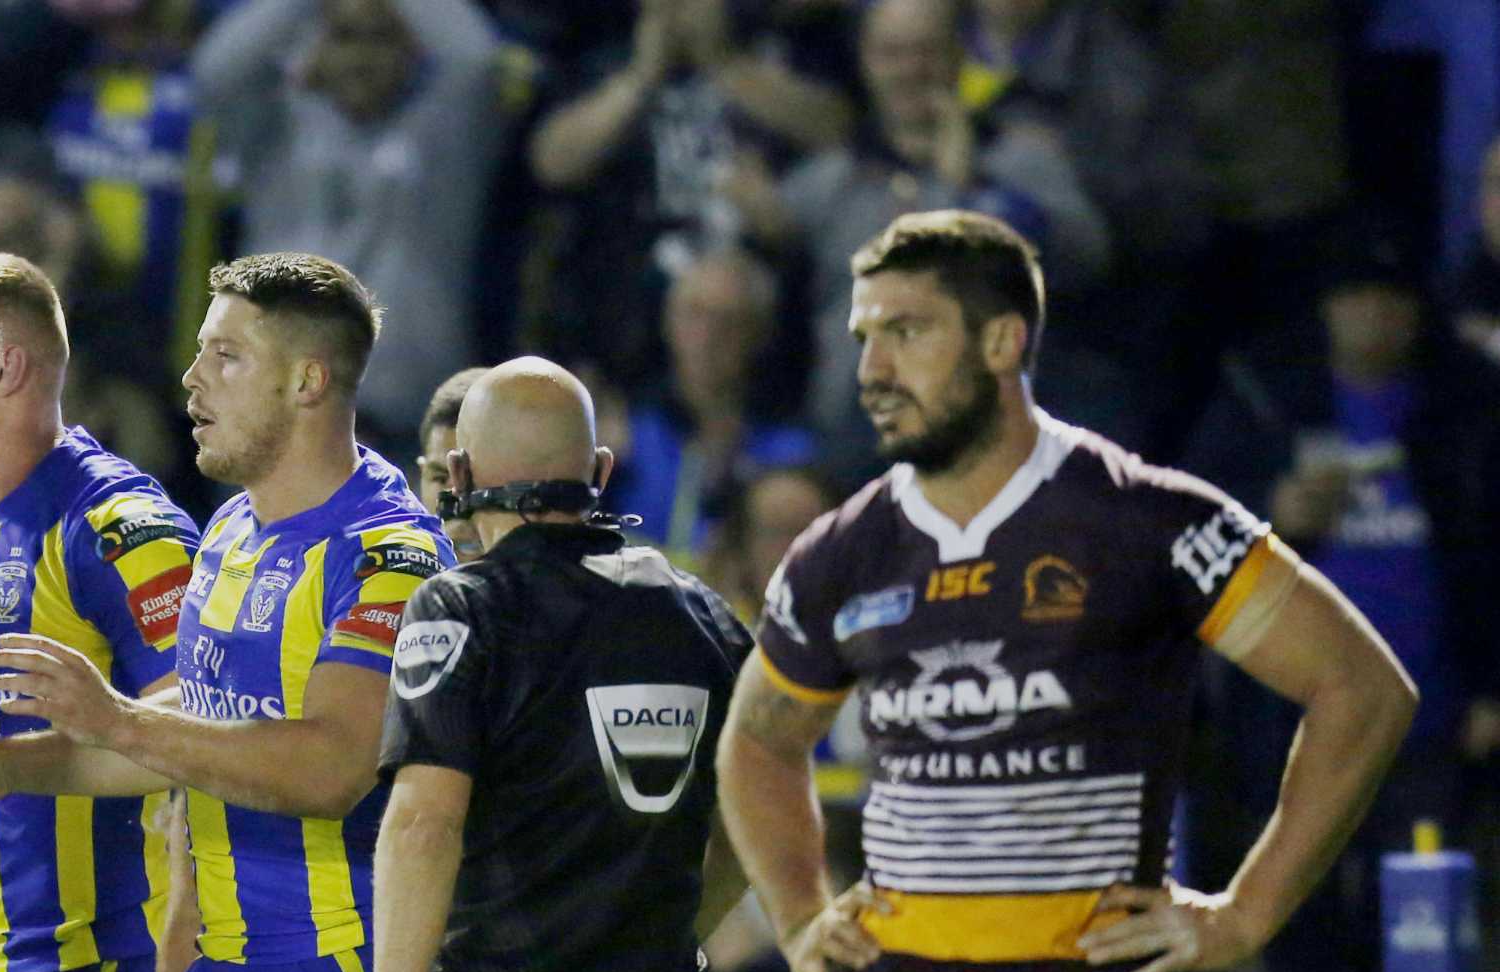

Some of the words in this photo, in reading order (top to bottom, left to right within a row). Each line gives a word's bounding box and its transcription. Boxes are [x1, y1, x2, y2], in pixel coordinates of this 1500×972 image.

[140, 583, 189, 614] Kingst
[925, 561, 997, 602] ISC
[192, 634, 226, 679] Fly
[397, 633, 451, 653] DACIA
[178, 671, 287, 721] mirates
[612, 707, 696, 729] DACIA
